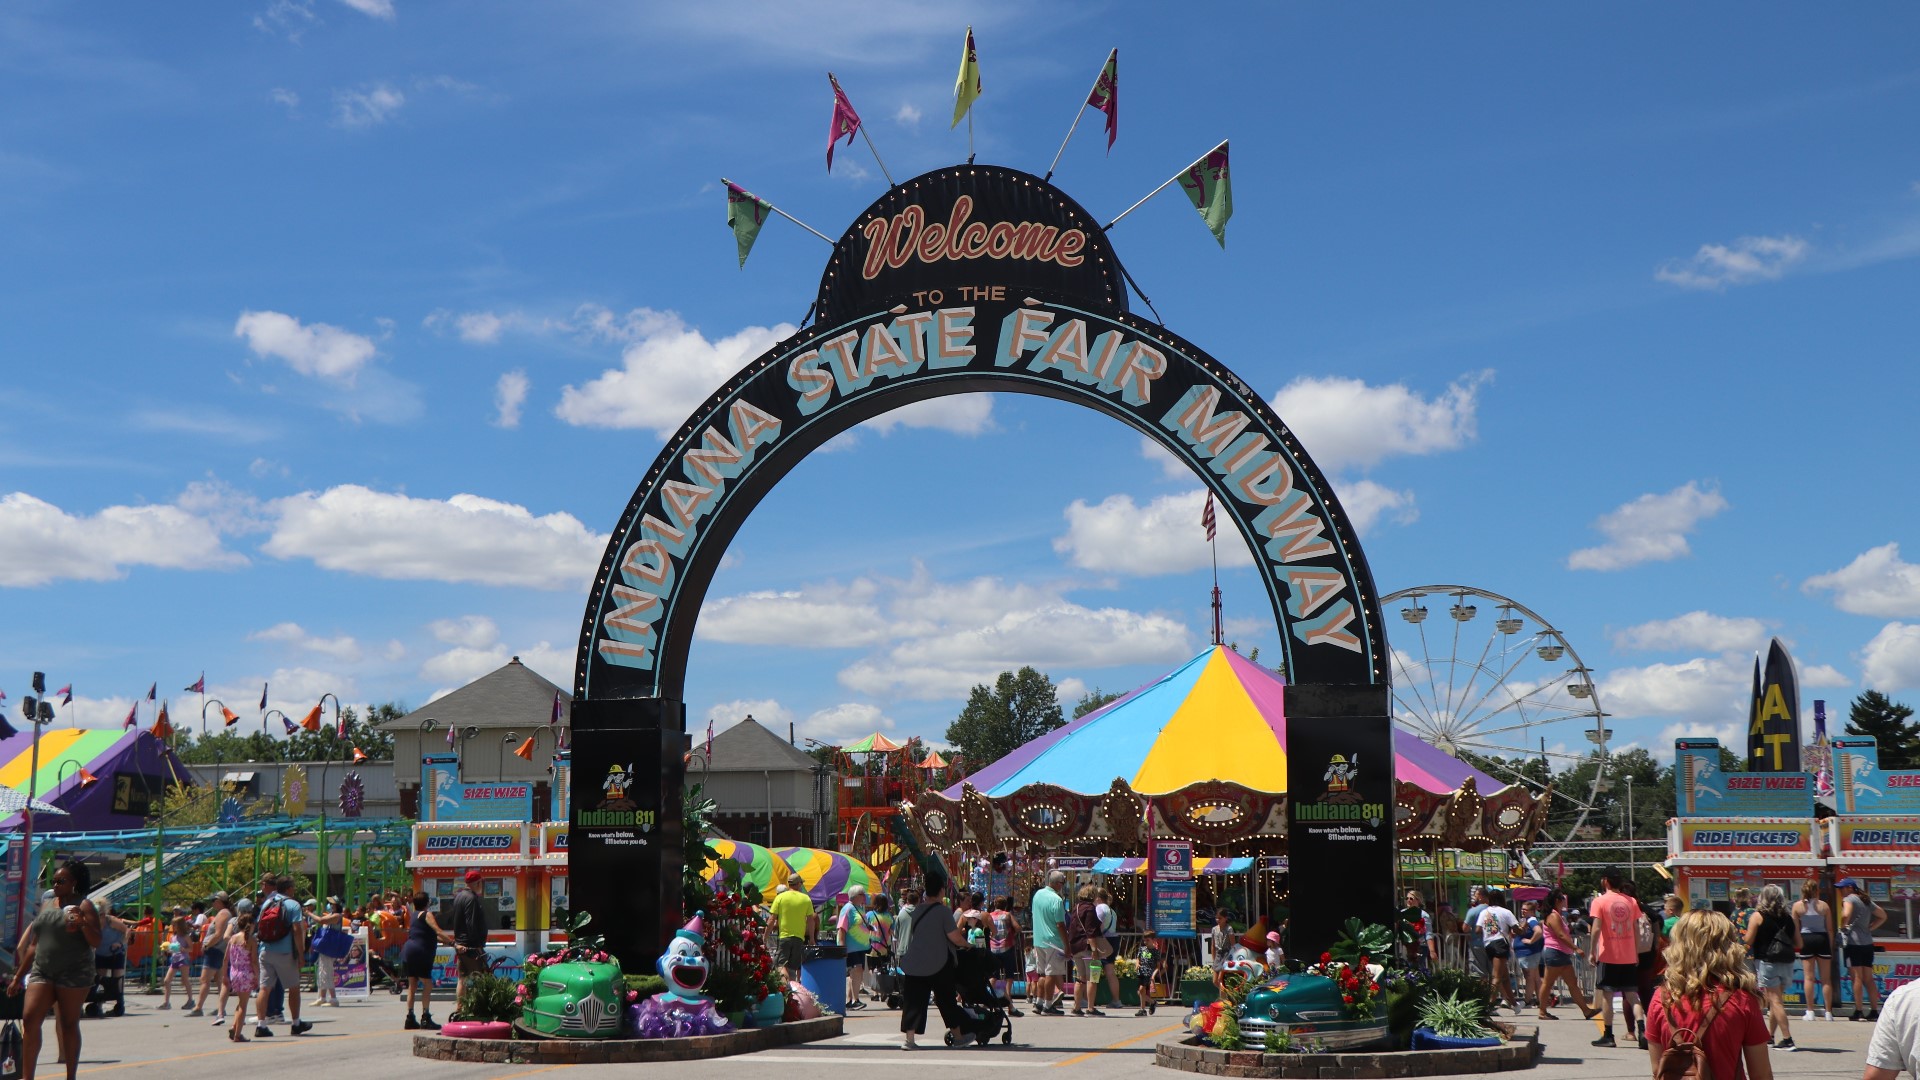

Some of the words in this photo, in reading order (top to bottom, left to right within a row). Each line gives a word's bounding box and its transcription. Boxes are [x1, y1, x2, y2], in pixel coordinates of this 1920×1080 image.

[862, 195, 1086, 280] Welcome
[913, 290, 944, 307] TO
[958, 286, 1006, 302] THE
[599, 398, 782, 665] INDIANA
[787, 306, 977, 408] STATE
[999, 308, 1168, 404] FAIR
[1163, 385, 1362, 653] MIDWAY
[1727, 777, 1761, 790] SIZE
[1765, 777, 1806, 790] WIZE
[463, 787, 492, 799] SIZE
[493, 786, 527, 798] WIZE
[577, 809, 634, 826] Indiana
[635, 810, 655, 825] 811
[1295, 801, 1361, 820] Indiana
[1362, 803, 1384, 819] 811
[426, 835, 458, 849] RIDE
[459, 834, 513, 848] TICKETS
[1693, 830, 1733, 845] RIDE
[1735, 830, 1800, 845] TICKETS
[1851, 829, 1892, 844] RIDE
